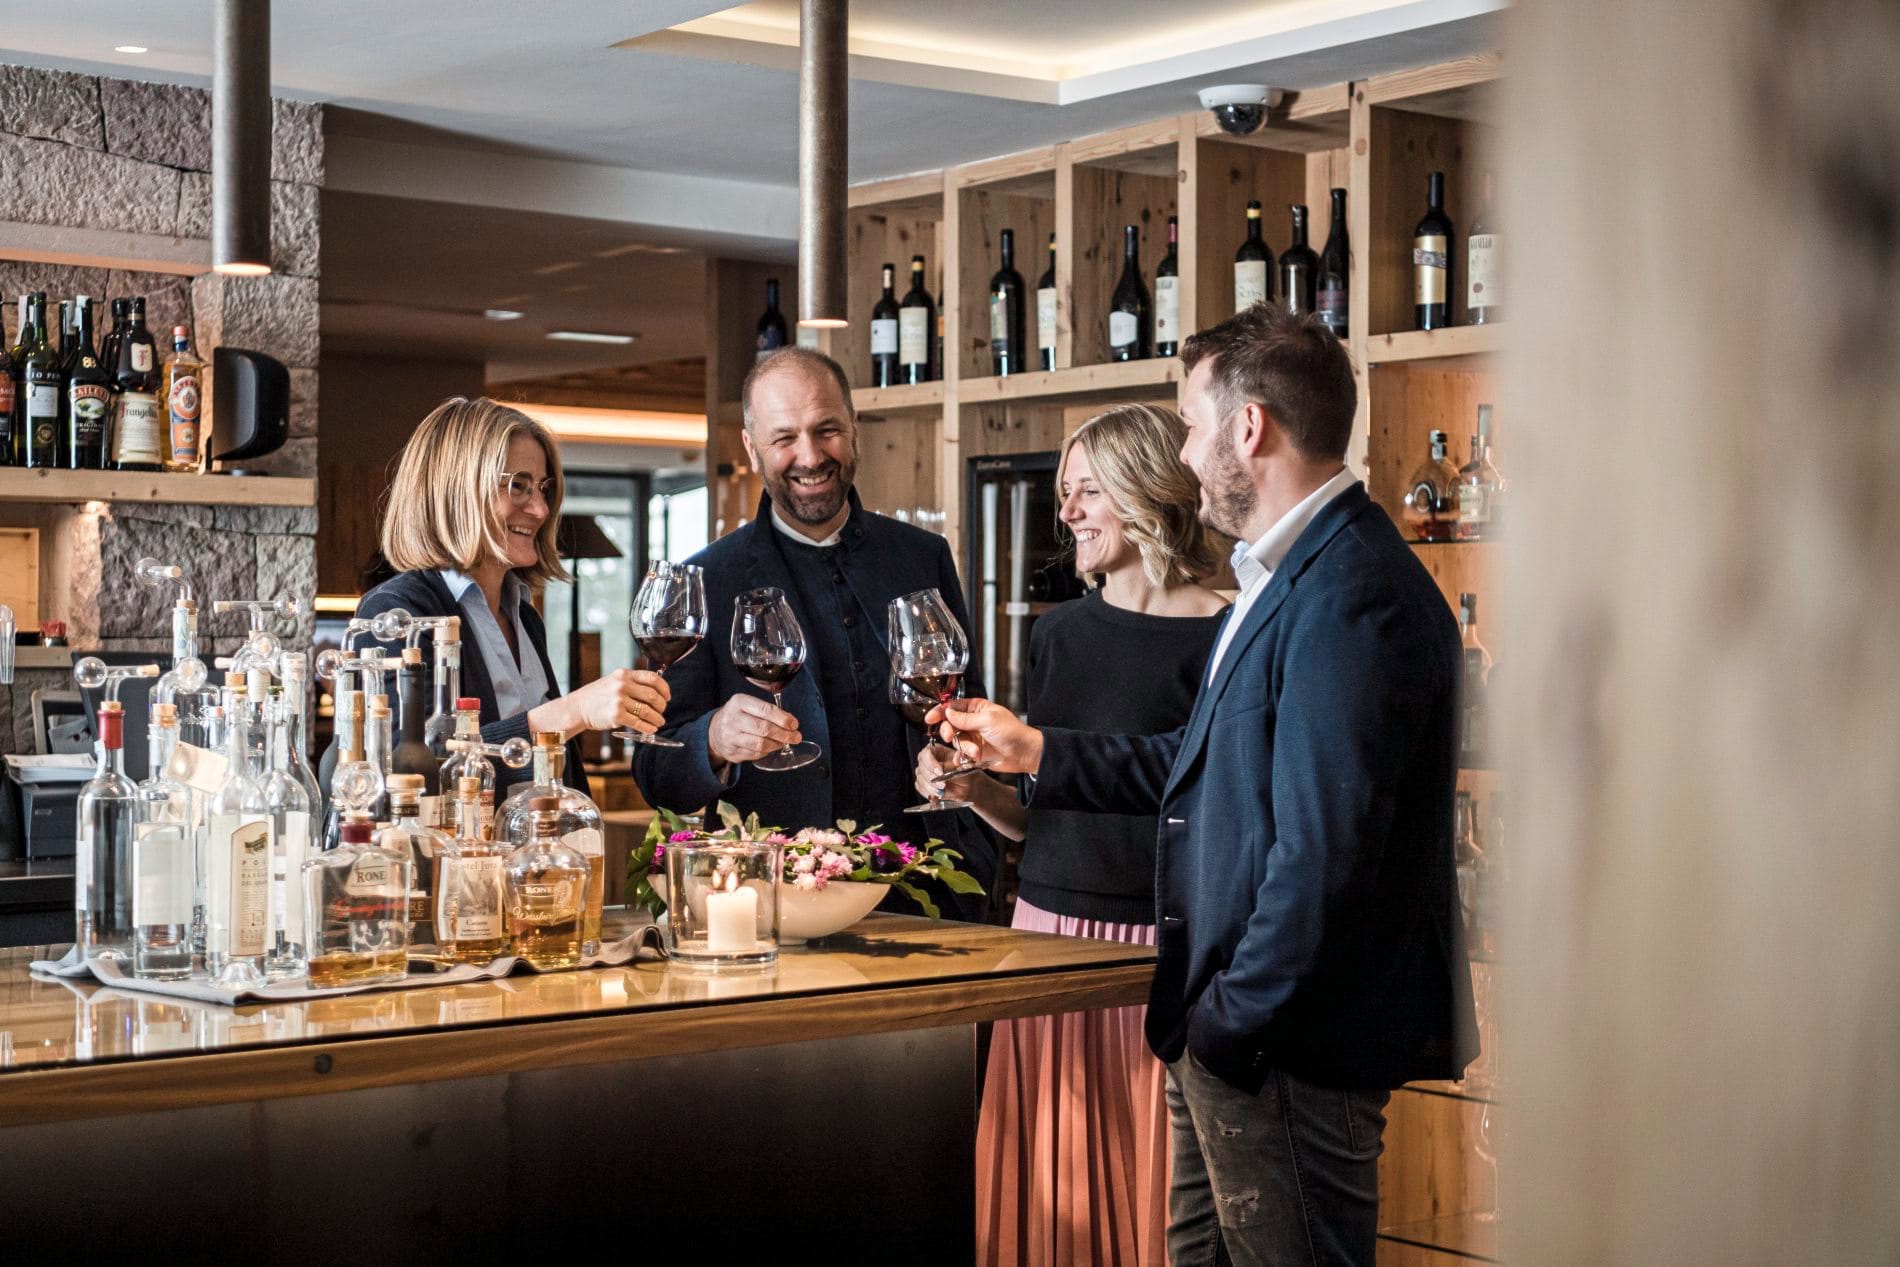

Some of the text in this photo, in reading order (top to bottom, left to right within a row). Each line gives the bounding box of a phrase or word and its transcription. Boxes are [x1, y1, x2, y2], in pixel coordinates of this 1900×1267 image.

[72, 386, 108, 398] AILEY
[120, 402, 158, 419] Frangel
[356, 870, 387, 882] RONE
